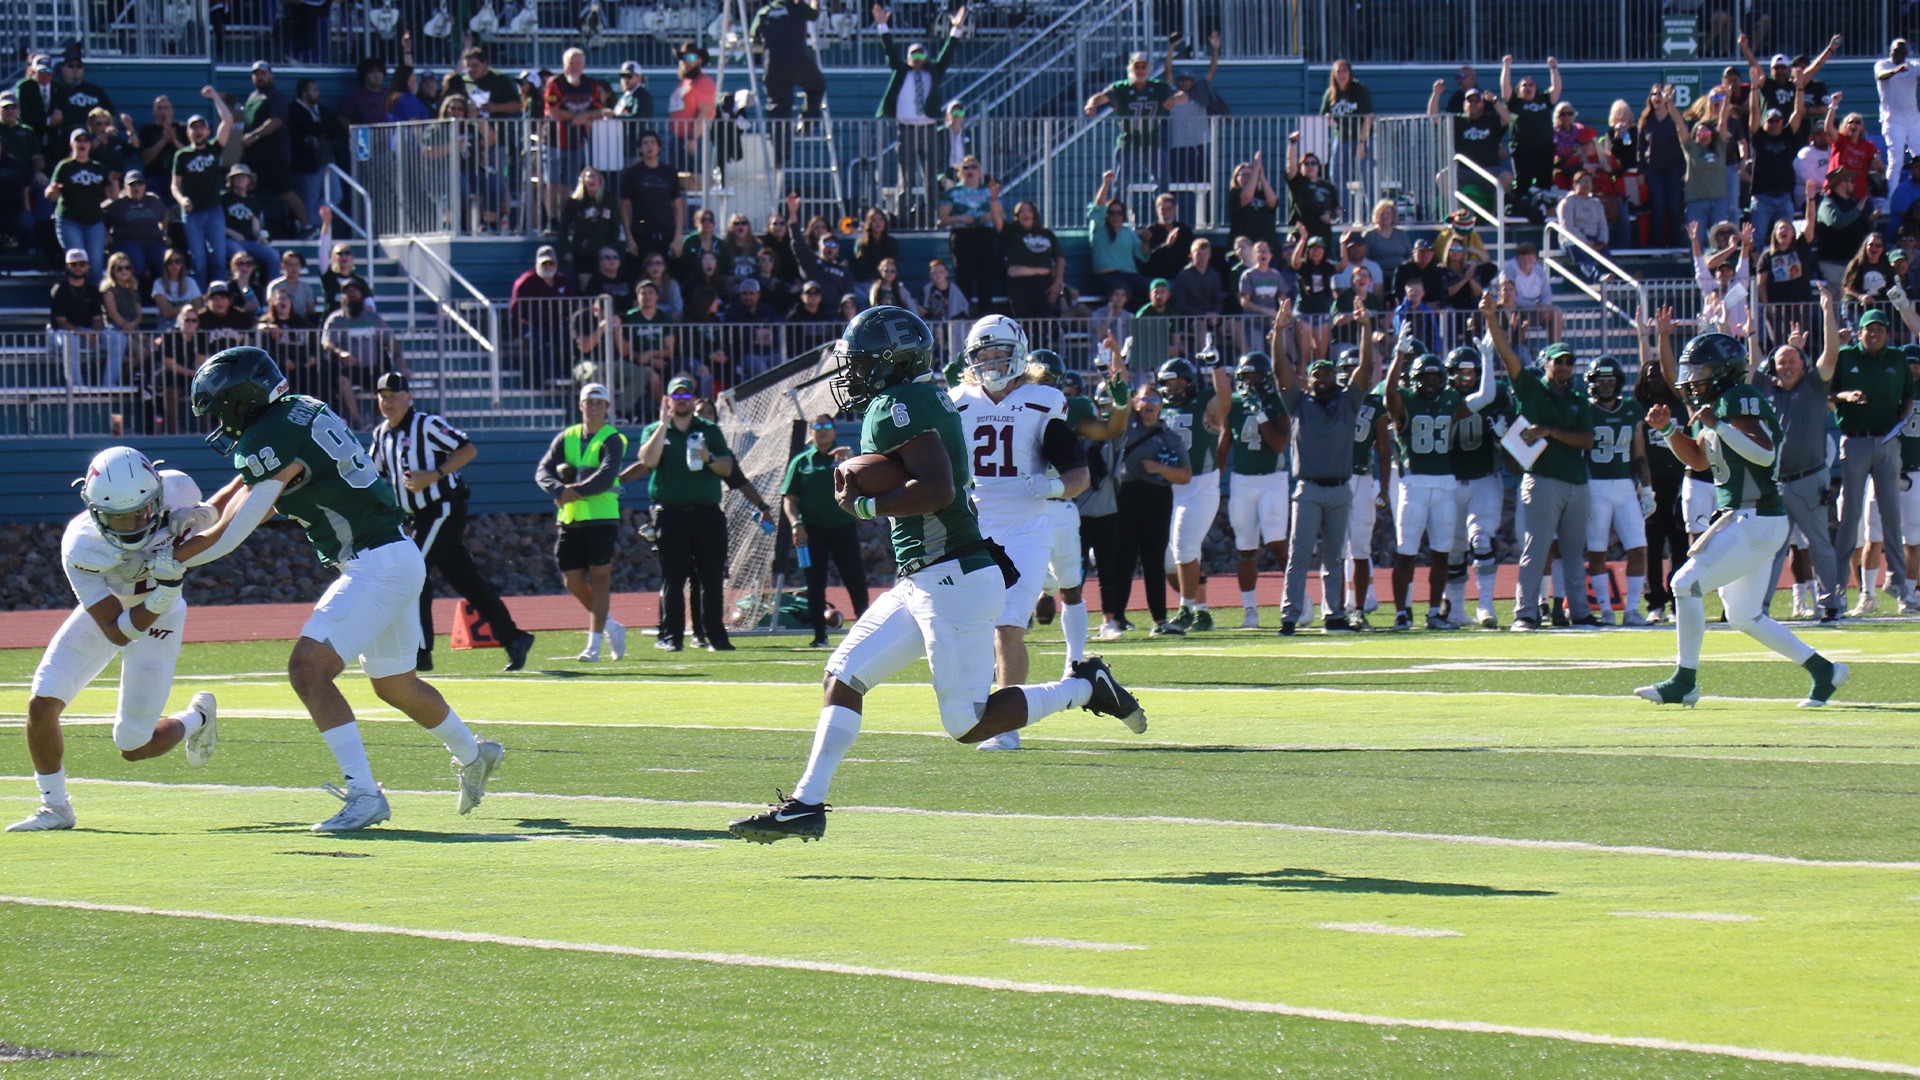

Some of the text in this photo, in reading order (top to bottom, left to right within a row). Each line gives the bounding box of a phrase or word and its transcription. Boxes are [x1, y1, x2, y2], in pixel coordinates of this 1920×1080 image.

[1674, 84, 1692, 108] B
[882, 317, 921, 352] E
[890, 403, 911, 429] 6
[976, 414, 1016, 424] BUFFALOES
[1411, 414, 1451, 455] 83
[1590, 425, 1633, 464] 34
[245, 446, 282, 478] 82
[973, 424, 1018, 478] 21
[148, 627, 174, 640] WT
